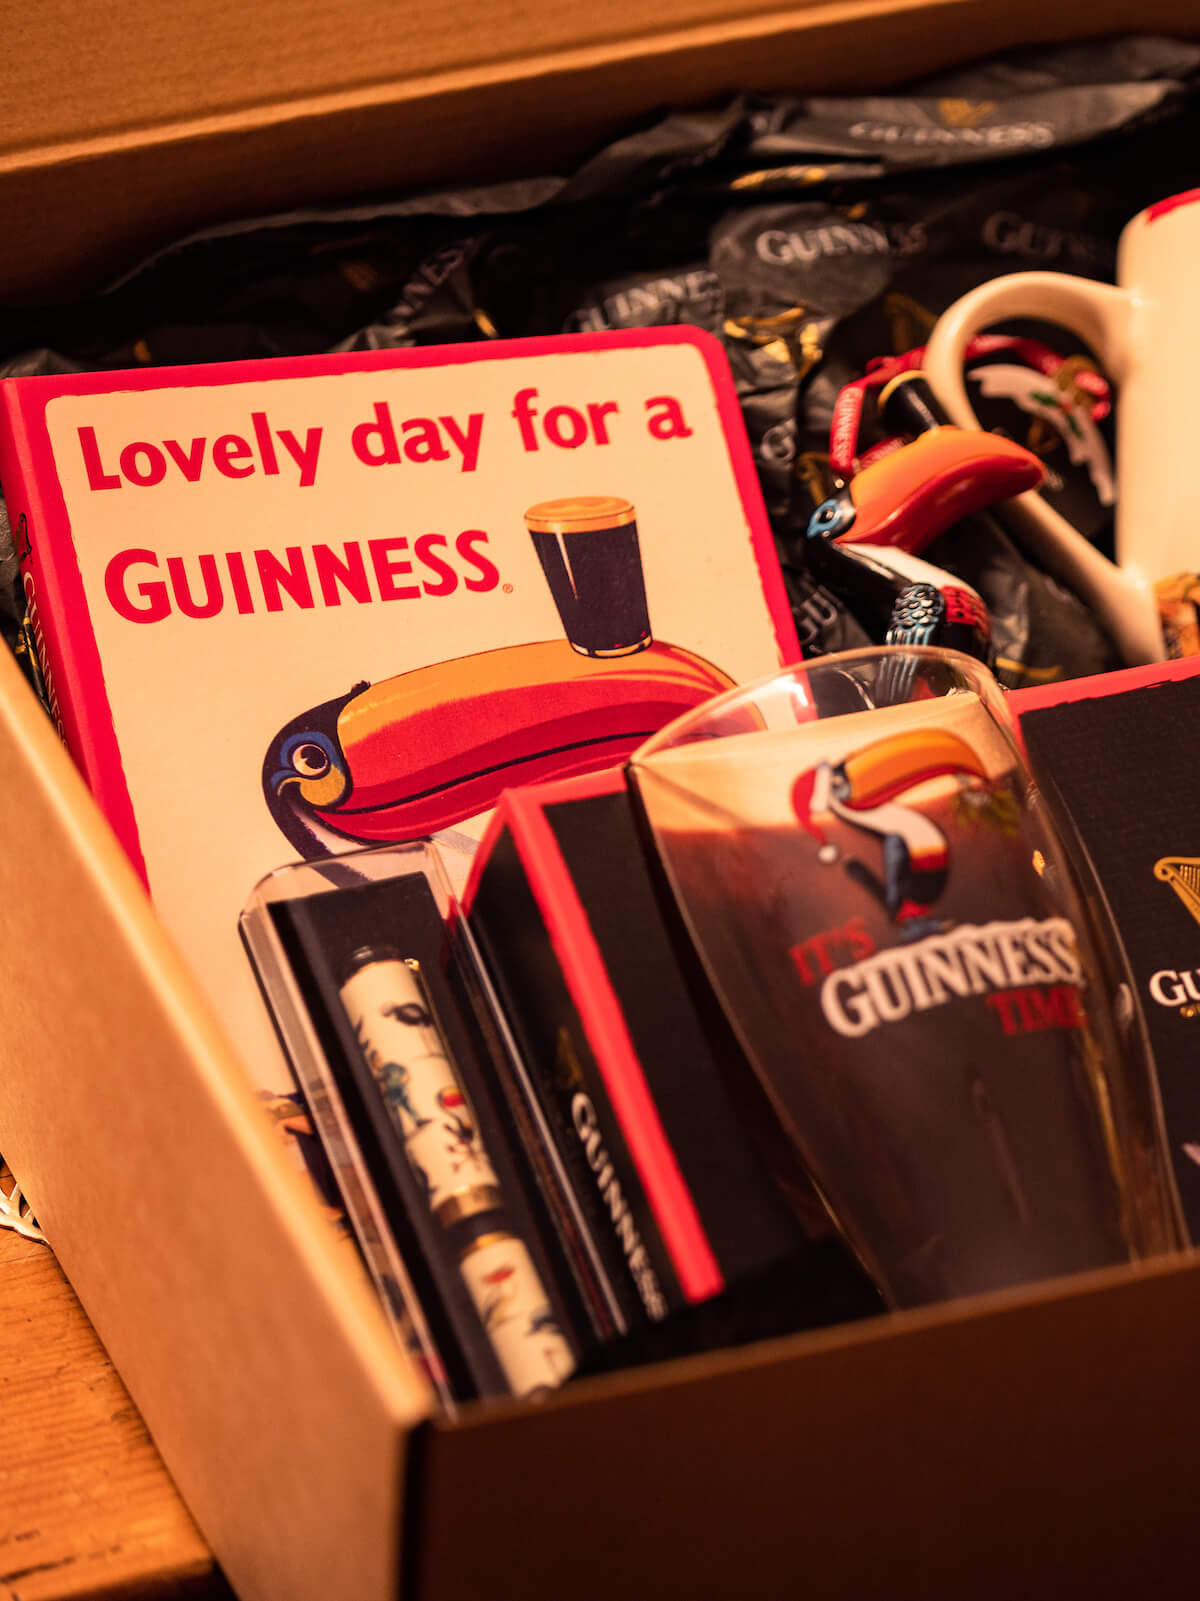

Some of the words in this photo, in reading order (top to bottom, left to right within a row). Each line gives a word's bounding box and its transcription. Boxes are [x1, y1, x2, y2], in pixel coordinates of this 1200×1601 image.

[77, 411, 323, 492] Lovely
[351, 401, 485, 473] day
[512, 388, 620, 453] for
[645, 394, 694, 440] a
[820, 930, 1084, 1038] GUINNESS
